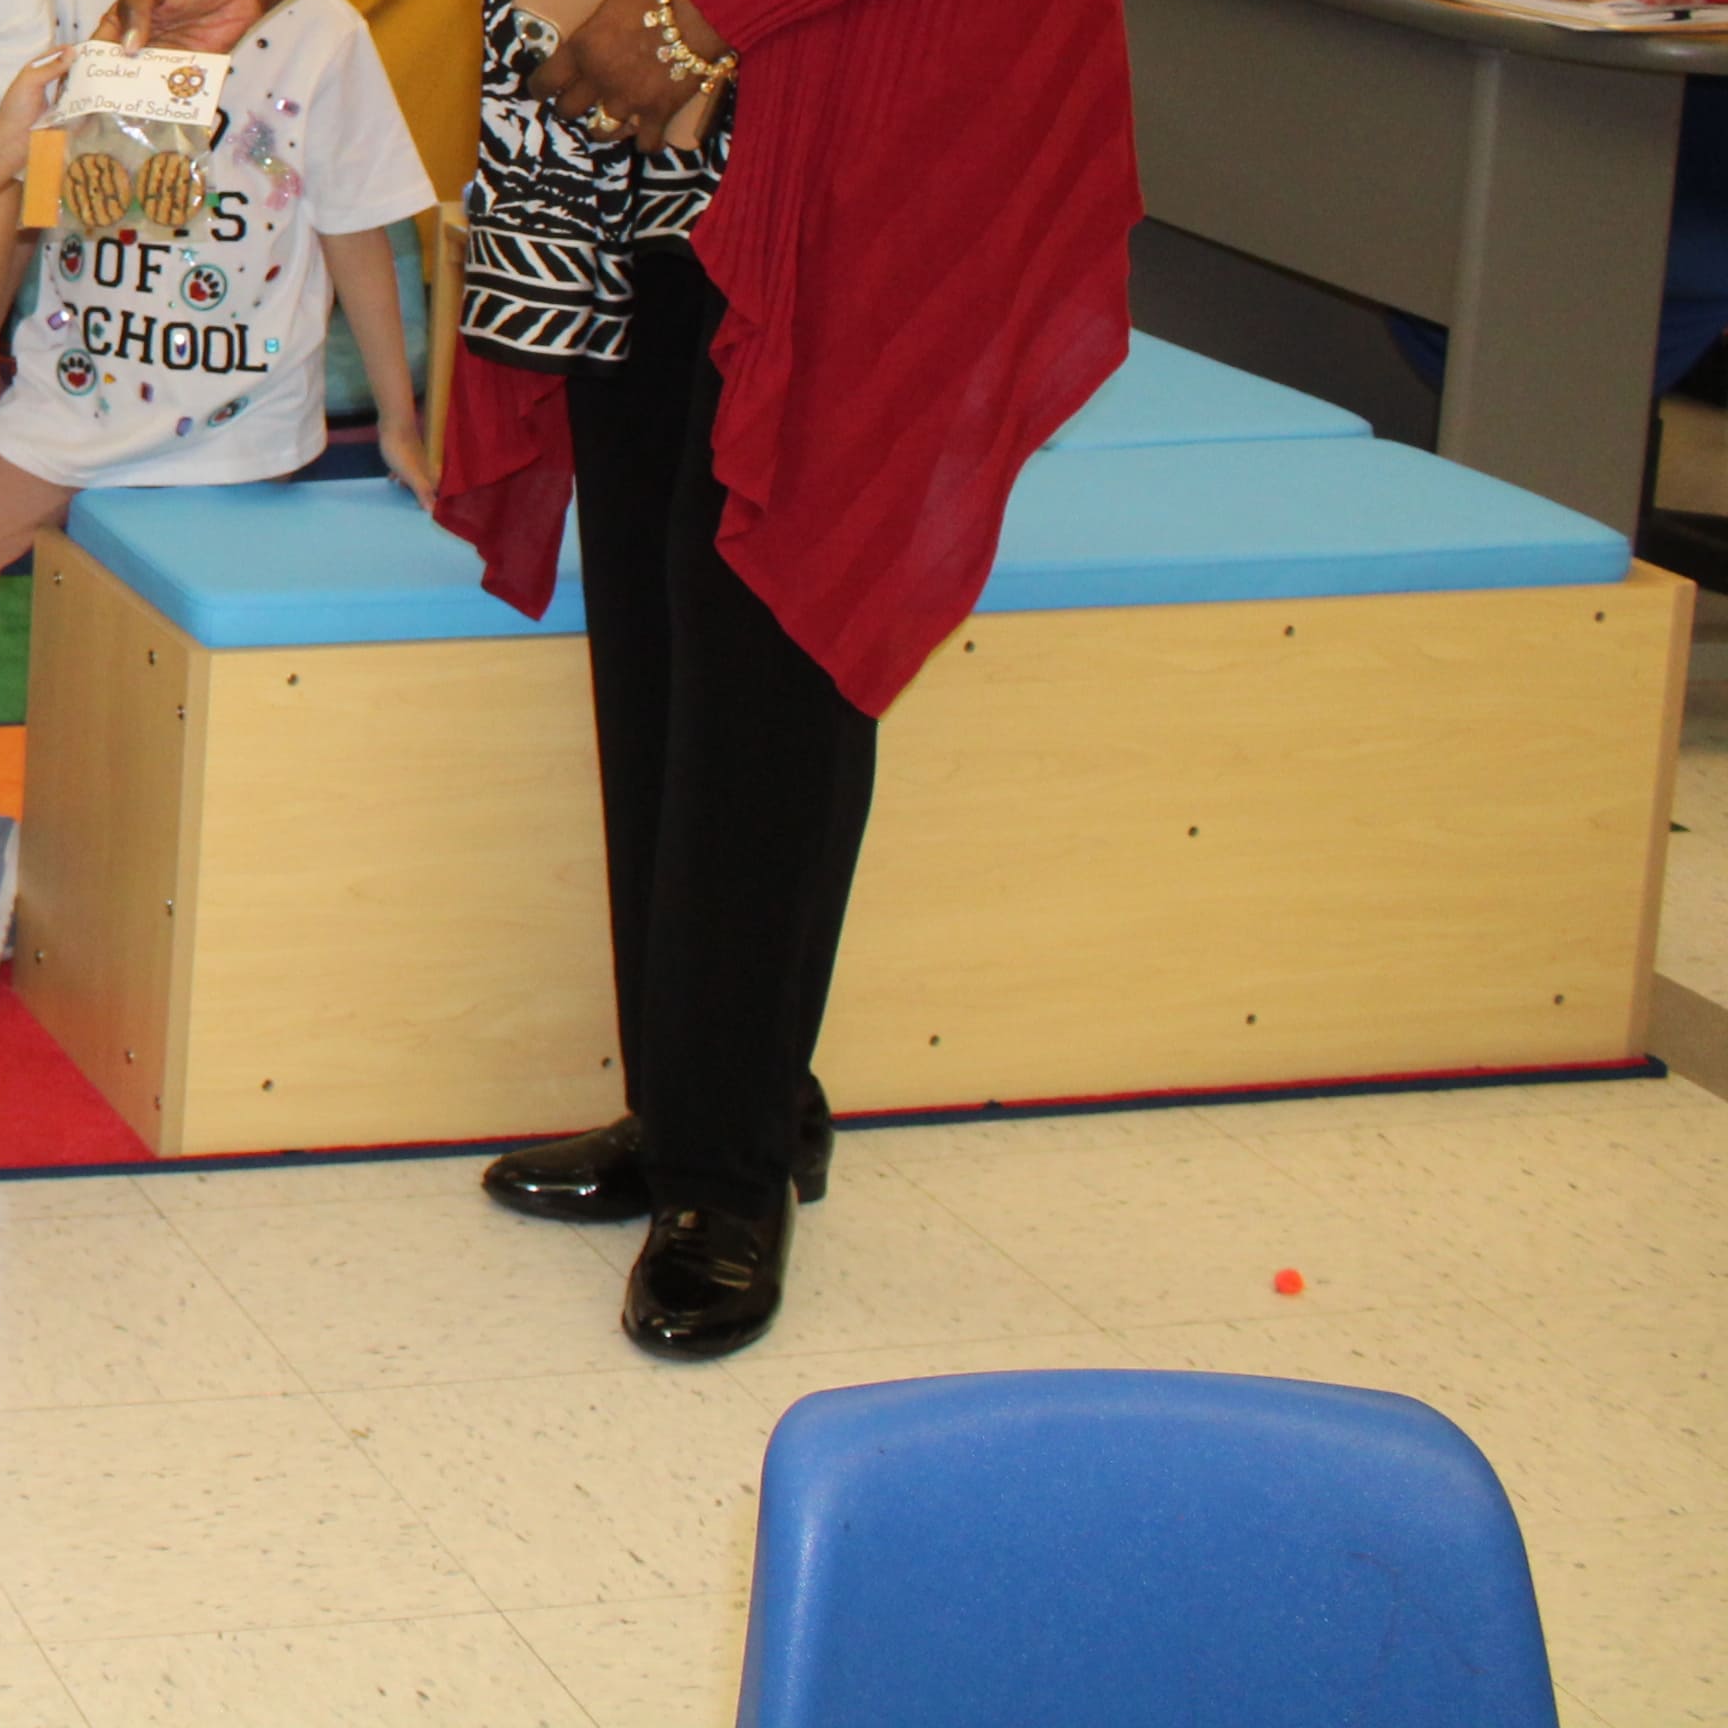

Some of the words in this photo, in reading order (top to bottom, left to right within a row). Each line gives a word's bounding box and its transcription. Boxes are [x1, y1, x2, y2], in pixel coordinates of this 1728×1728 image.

[80, 45, 105, 57] Are
[144, 50, 196, 63] Smart
[95, 96, 121, 112] Day
[125, 100, 142, 111] of
[94, 237, 171, 293] OF
[63, 302, 268, 374] CHOOL
